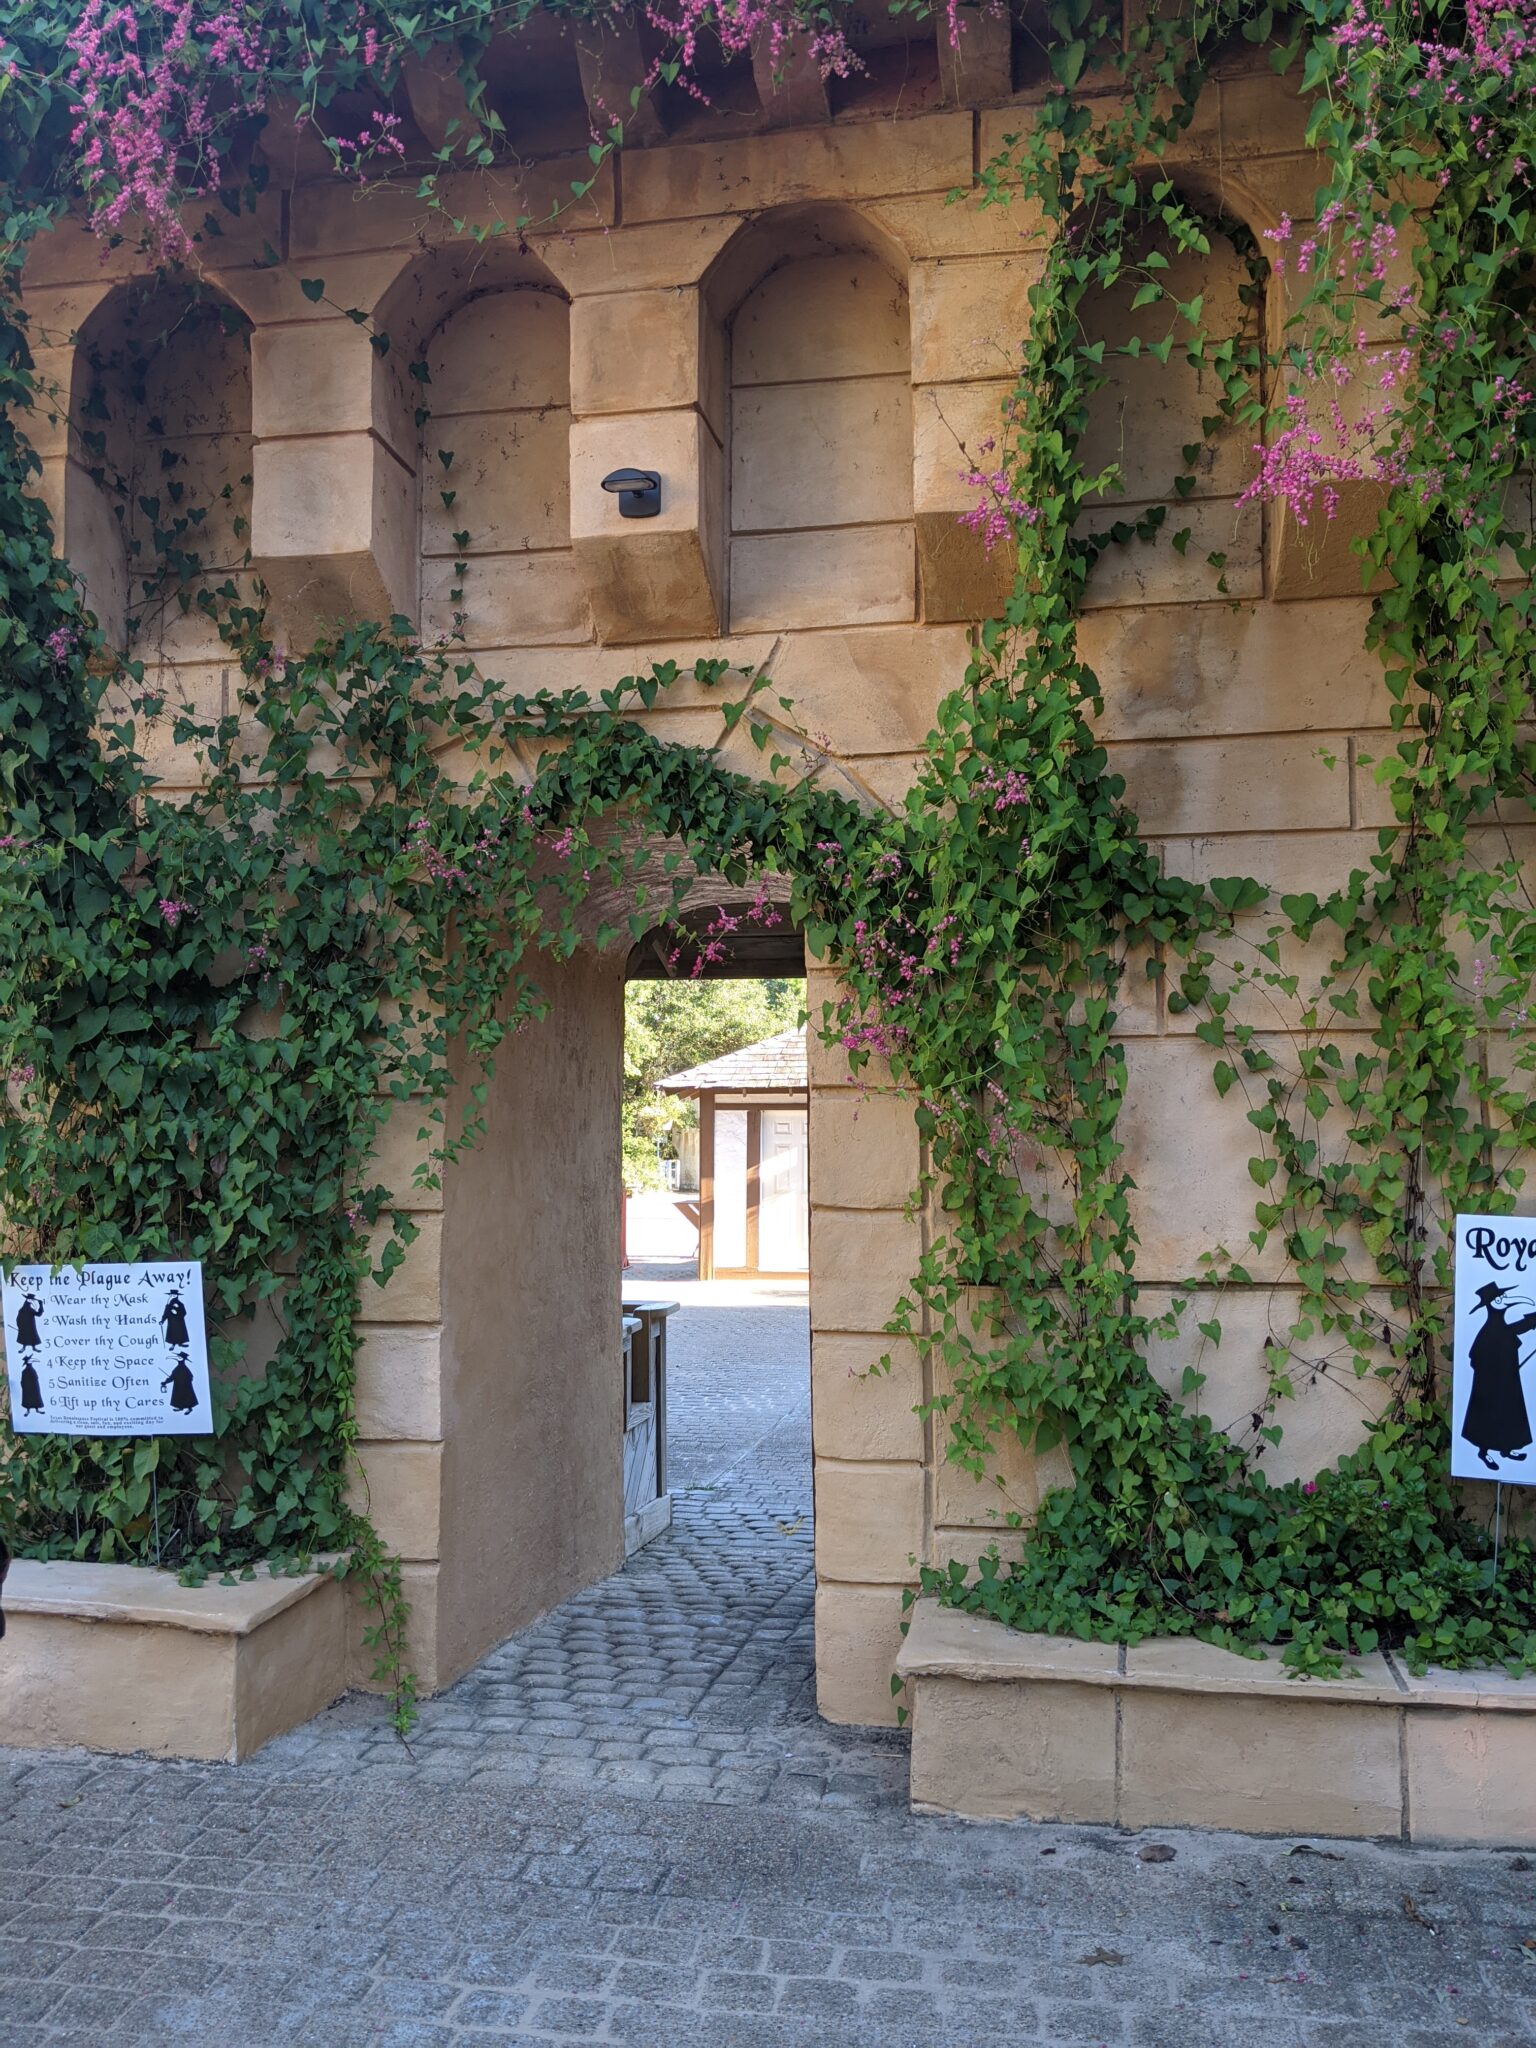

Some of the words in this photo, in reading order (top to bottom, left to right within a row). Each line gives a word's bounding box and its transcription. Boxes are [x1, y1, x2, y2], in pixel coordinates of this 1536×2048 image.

[10, 1272, 43, 1292] Keep
[76, 1271, 131, 1291] Plague
[138, 1268, 191, 1288] Away!
[50, 1294, 86, 1306] Wear
[91, 1294, 110, 1309] thy
[114, 1293, 149, 1307] Mask
[43, 1318, 50, 1326] 2
[52, 1315, 87, 1326] Wash
[92, 1315, 111, 1329] thy
[115, 1313, 157, 1326] Hands
[45, 1338, 51, 1349] 3
[53, 1335, 91, 1348] Cover
[95, 1335, 114, 1350] thy
[118, 1334, 159, 1349] Cough
[46, 1358, 53, 1369] 4
[54, 1355, 87, 1370] Keep
[91, 1355, 110, 1370] thy
[113, 1355, 155, 1369] Space
[48, 1378, 55, 1389] 5
[57, 1375, 107, 1389] Sanitize
[112, 1375, 149, 1390] Often
[50, 1396, 57, 1406] 6
[58, 1396, 79, 1411] Lift
[83, 1399, 97, 1411] up
[101, 1396, 120, 1411] thy
[125, 1396, 165, 1409] Cares
